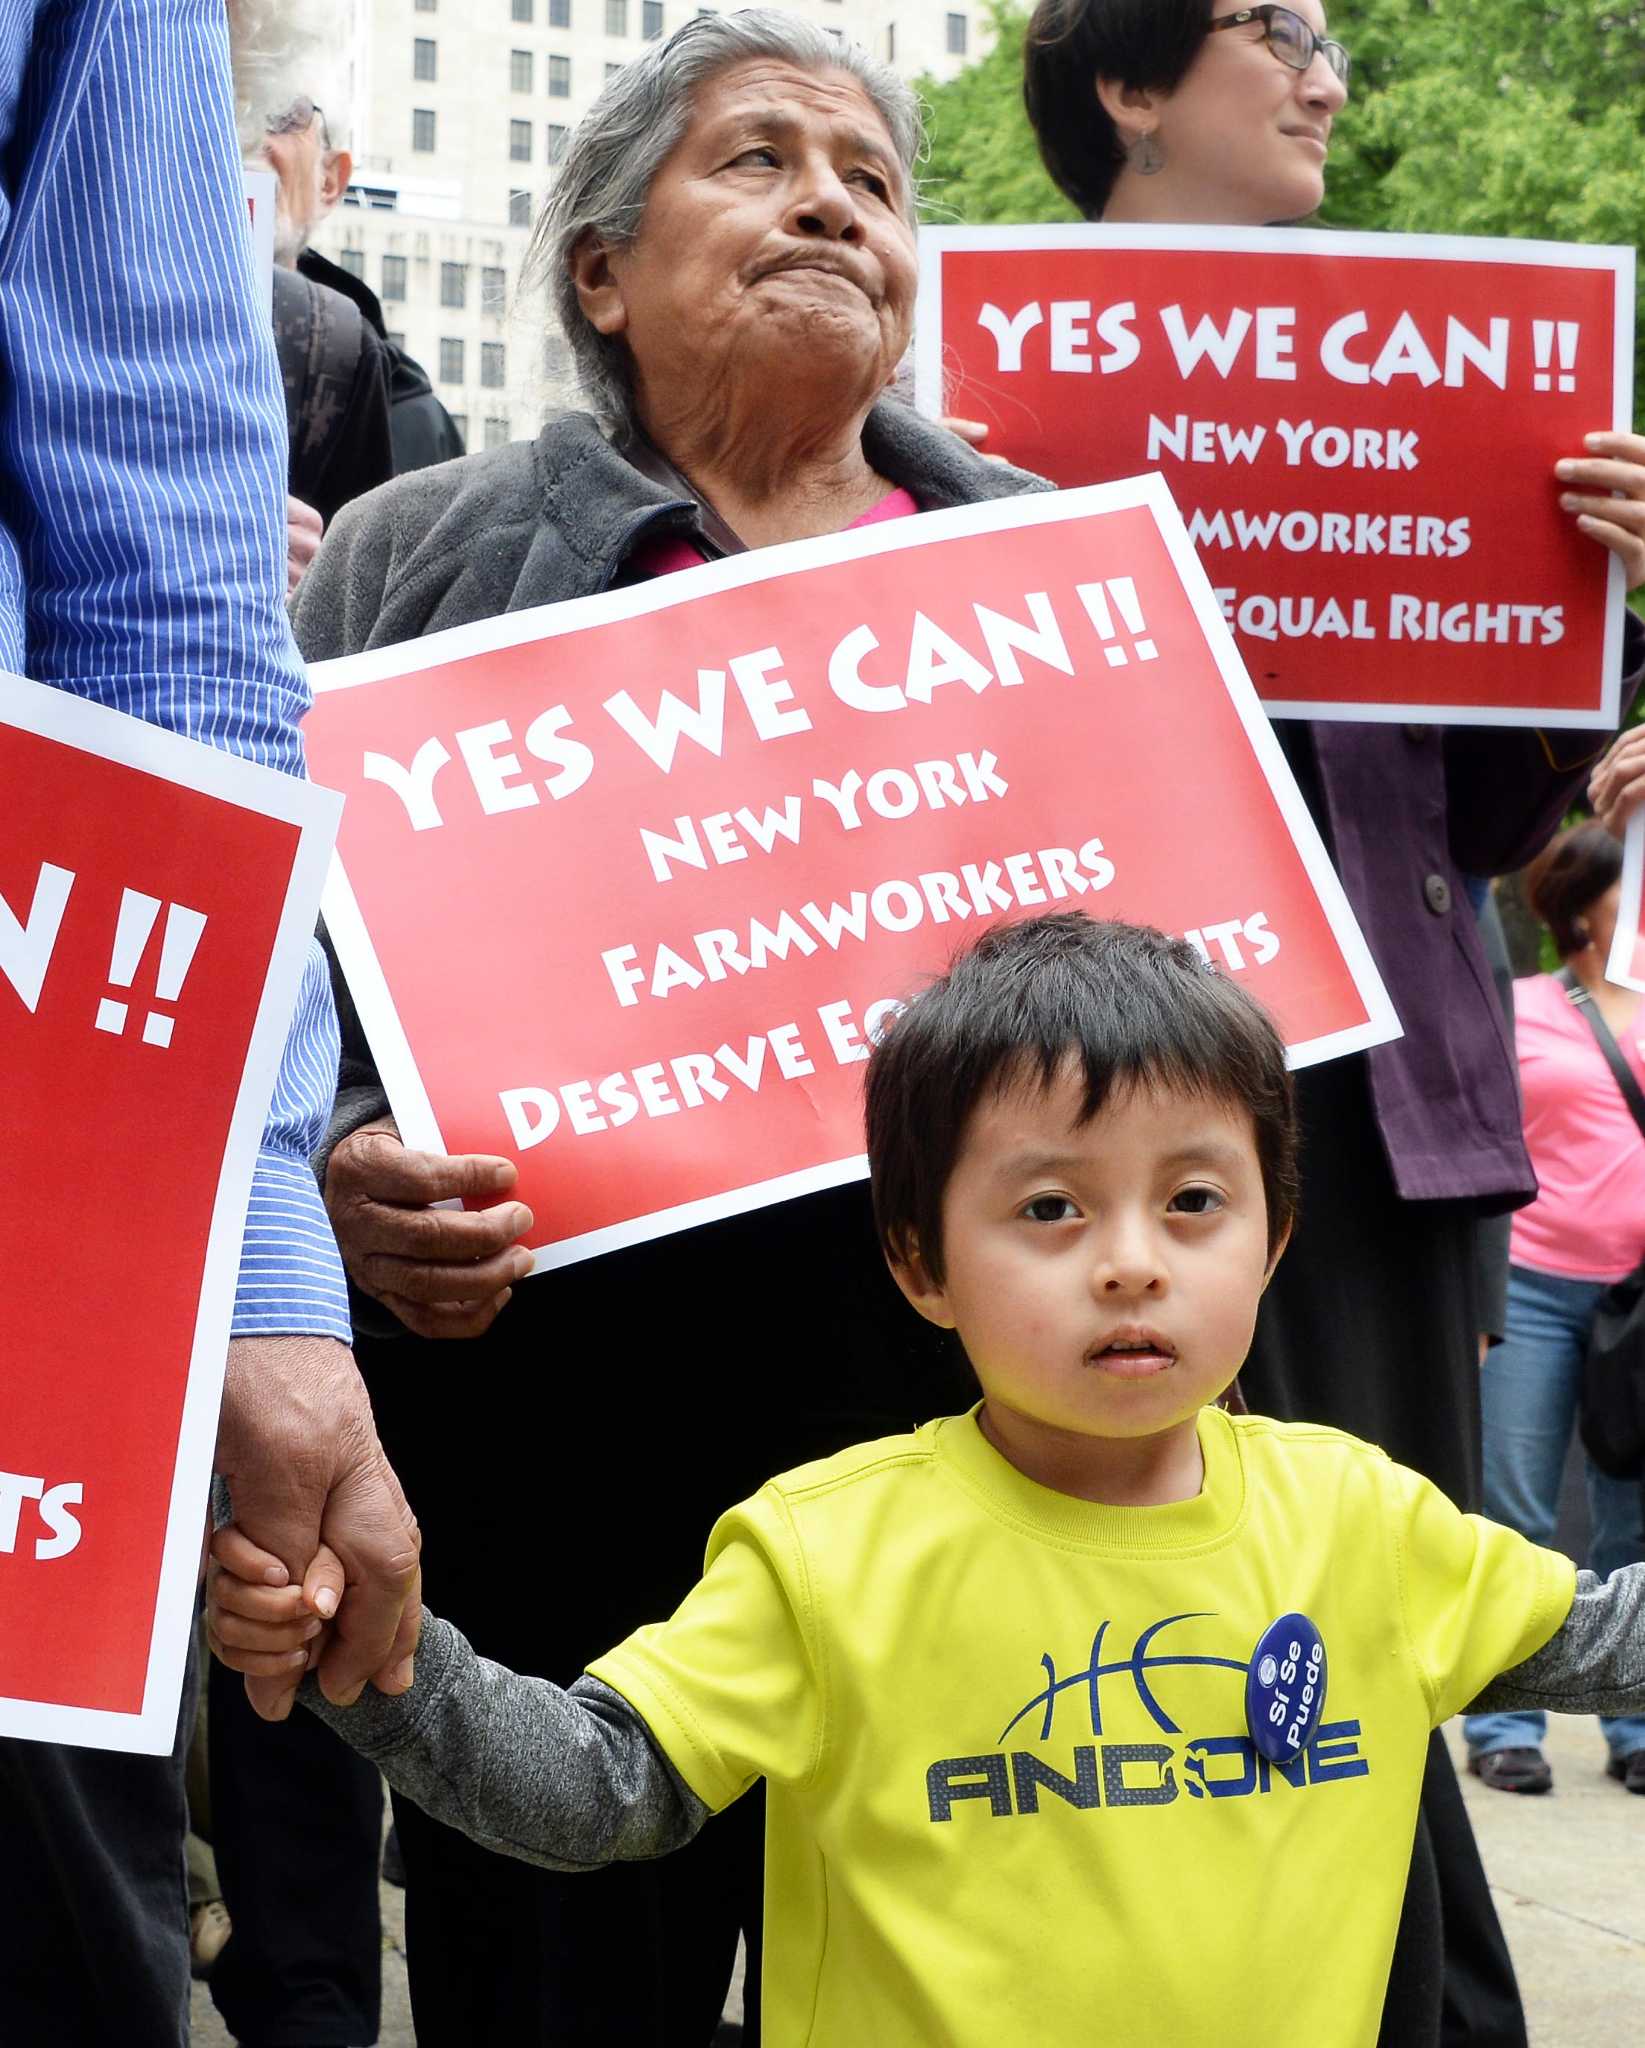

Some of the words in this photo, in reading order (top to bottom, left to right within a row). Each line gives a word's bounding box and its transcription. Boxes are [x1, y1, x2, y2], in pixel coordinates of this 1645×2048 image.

[978, 301, 1140, 374] YES
[1160, 304, 1296, 380] WE
[1320, 310, 1509, 390] CAN
[1532, 319, 1580, 392] !!
[1147, 413, 1266, 465] NEW
[1276, 418, 1419, 471] YORK
[1186, 508, 1471, 557] MWORKERS
[1389, 594, 1565, 645] RIGHTS
[363, 704, 594, 832] YES
[602, 646, 813, 775] WE
[828, 591, 1075, 712] CAN
[1075, 576, 1159, 668] !!
[639, 795, 801, 883] NEW
[812, 749, 1009, 830] YORK
[94, 886, 209, 1049] !!
[600, 838, 1116, 1008] FARMWORKERS
[498, 1022, 816, 1151] DESERVE
[1280, 1640, 1302, 1685] Se
[1286, 1643, 1323, 1749] Puede
[926, 1743, 1178, 1823] AND
[1184, 1719, 1370, 1799] ONE
